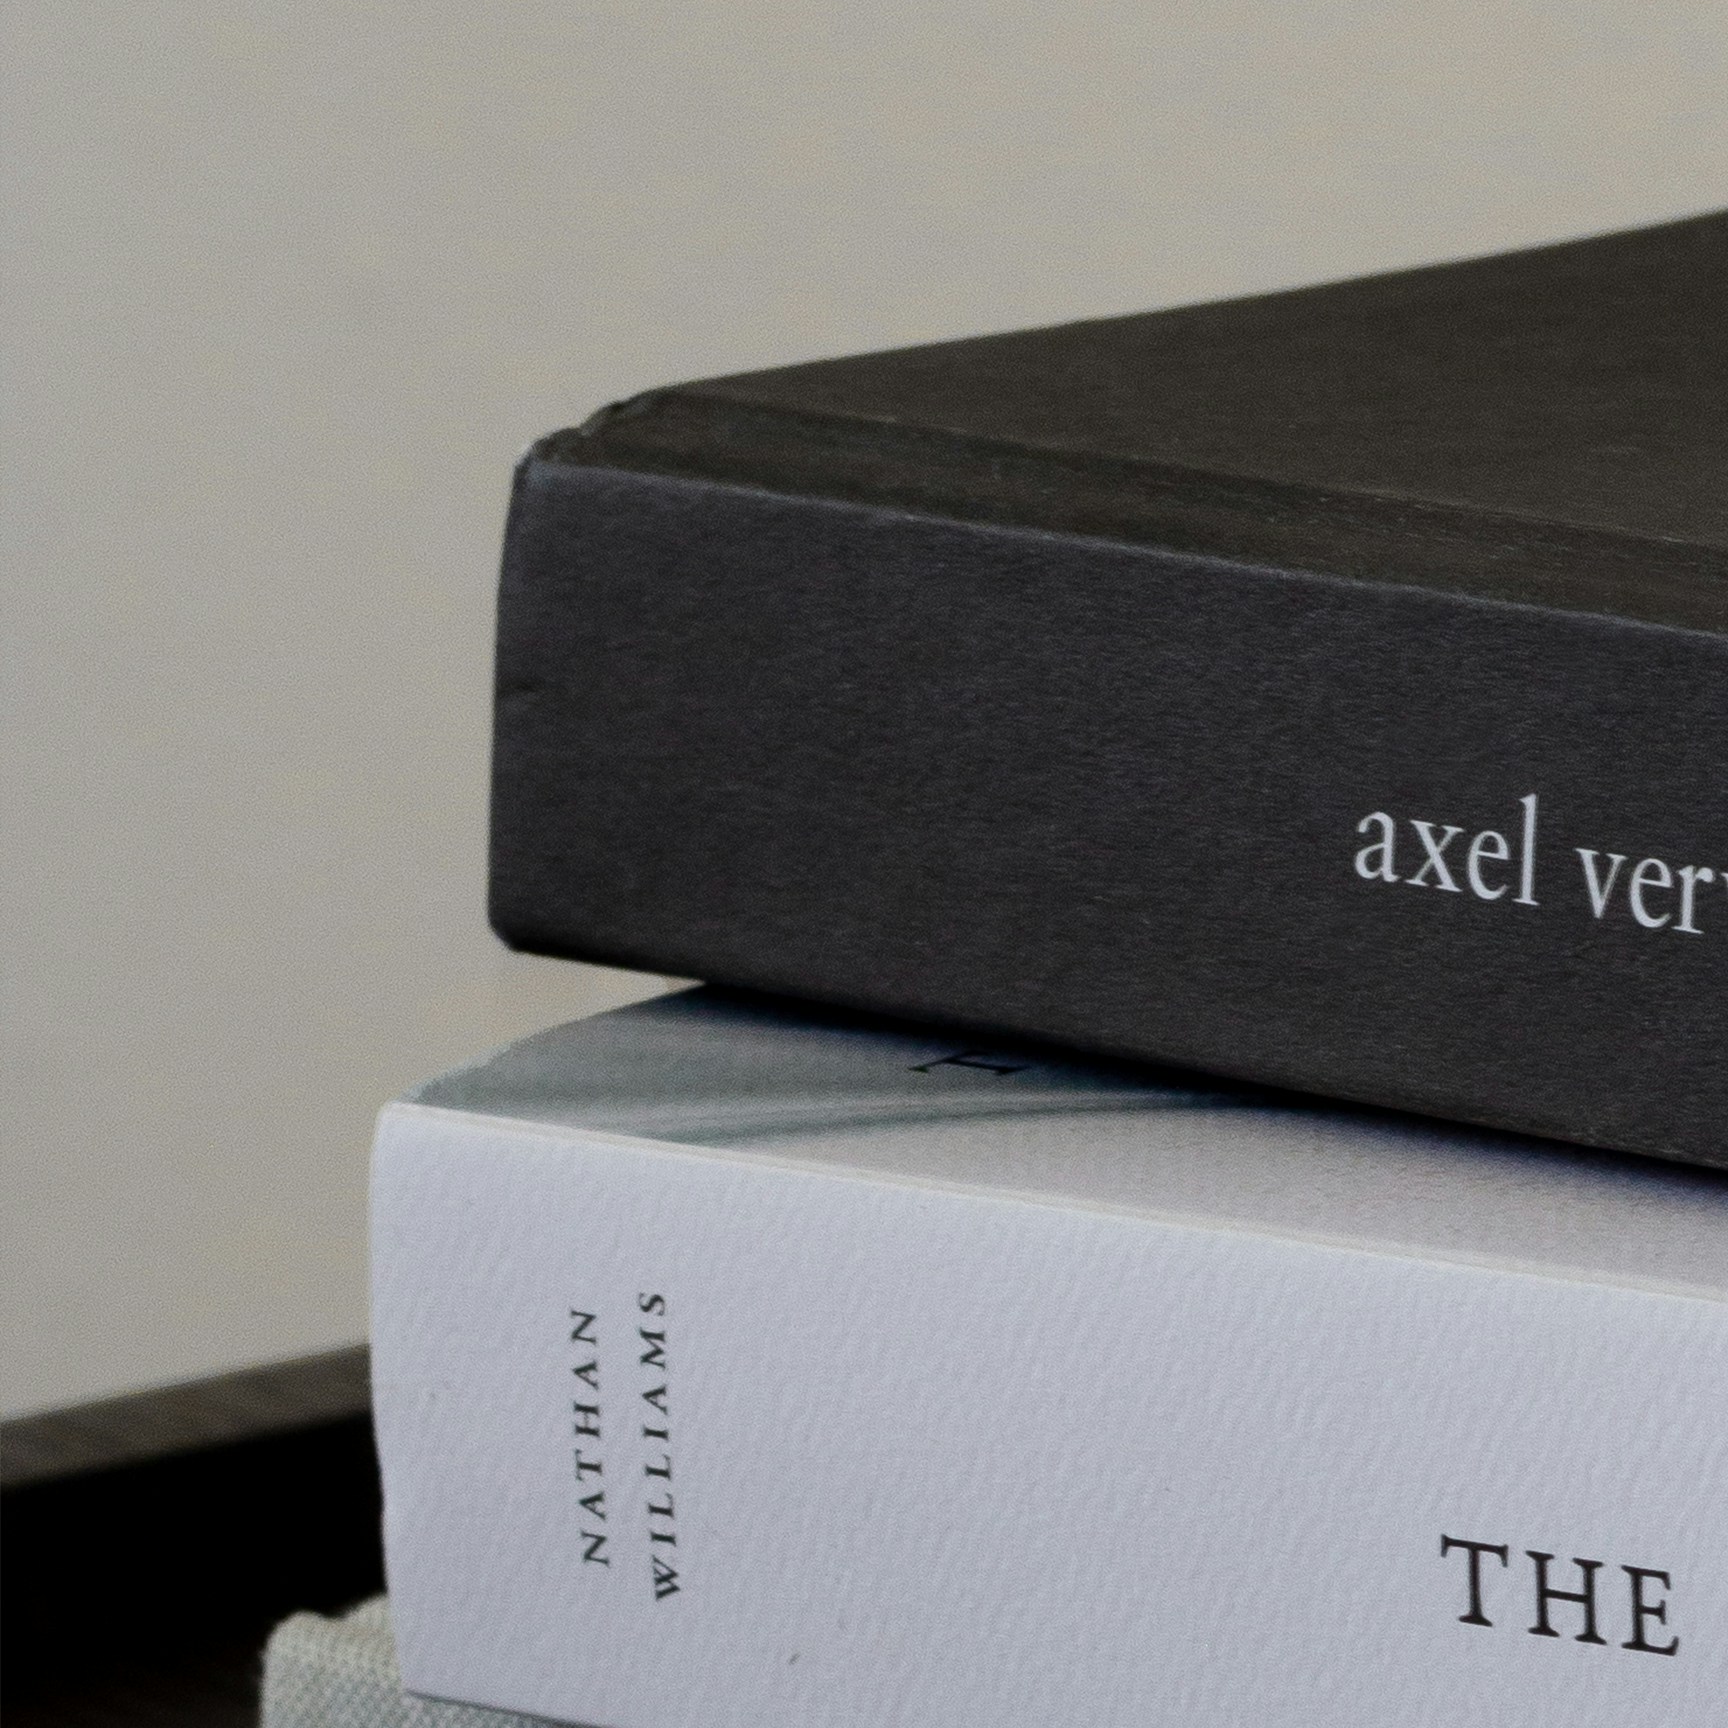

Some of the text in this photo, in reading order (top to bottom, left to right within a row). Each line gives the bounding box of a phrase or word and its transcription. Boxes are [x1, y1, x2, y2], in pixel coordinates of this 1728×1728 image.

[1354, 793, 1540, 906] axel
[570, 1308, 610, 1567] NATHAN
[638, 1292, 681, 1602] WILLIAMS
[1440, 1534, 1680, 1656] THE
